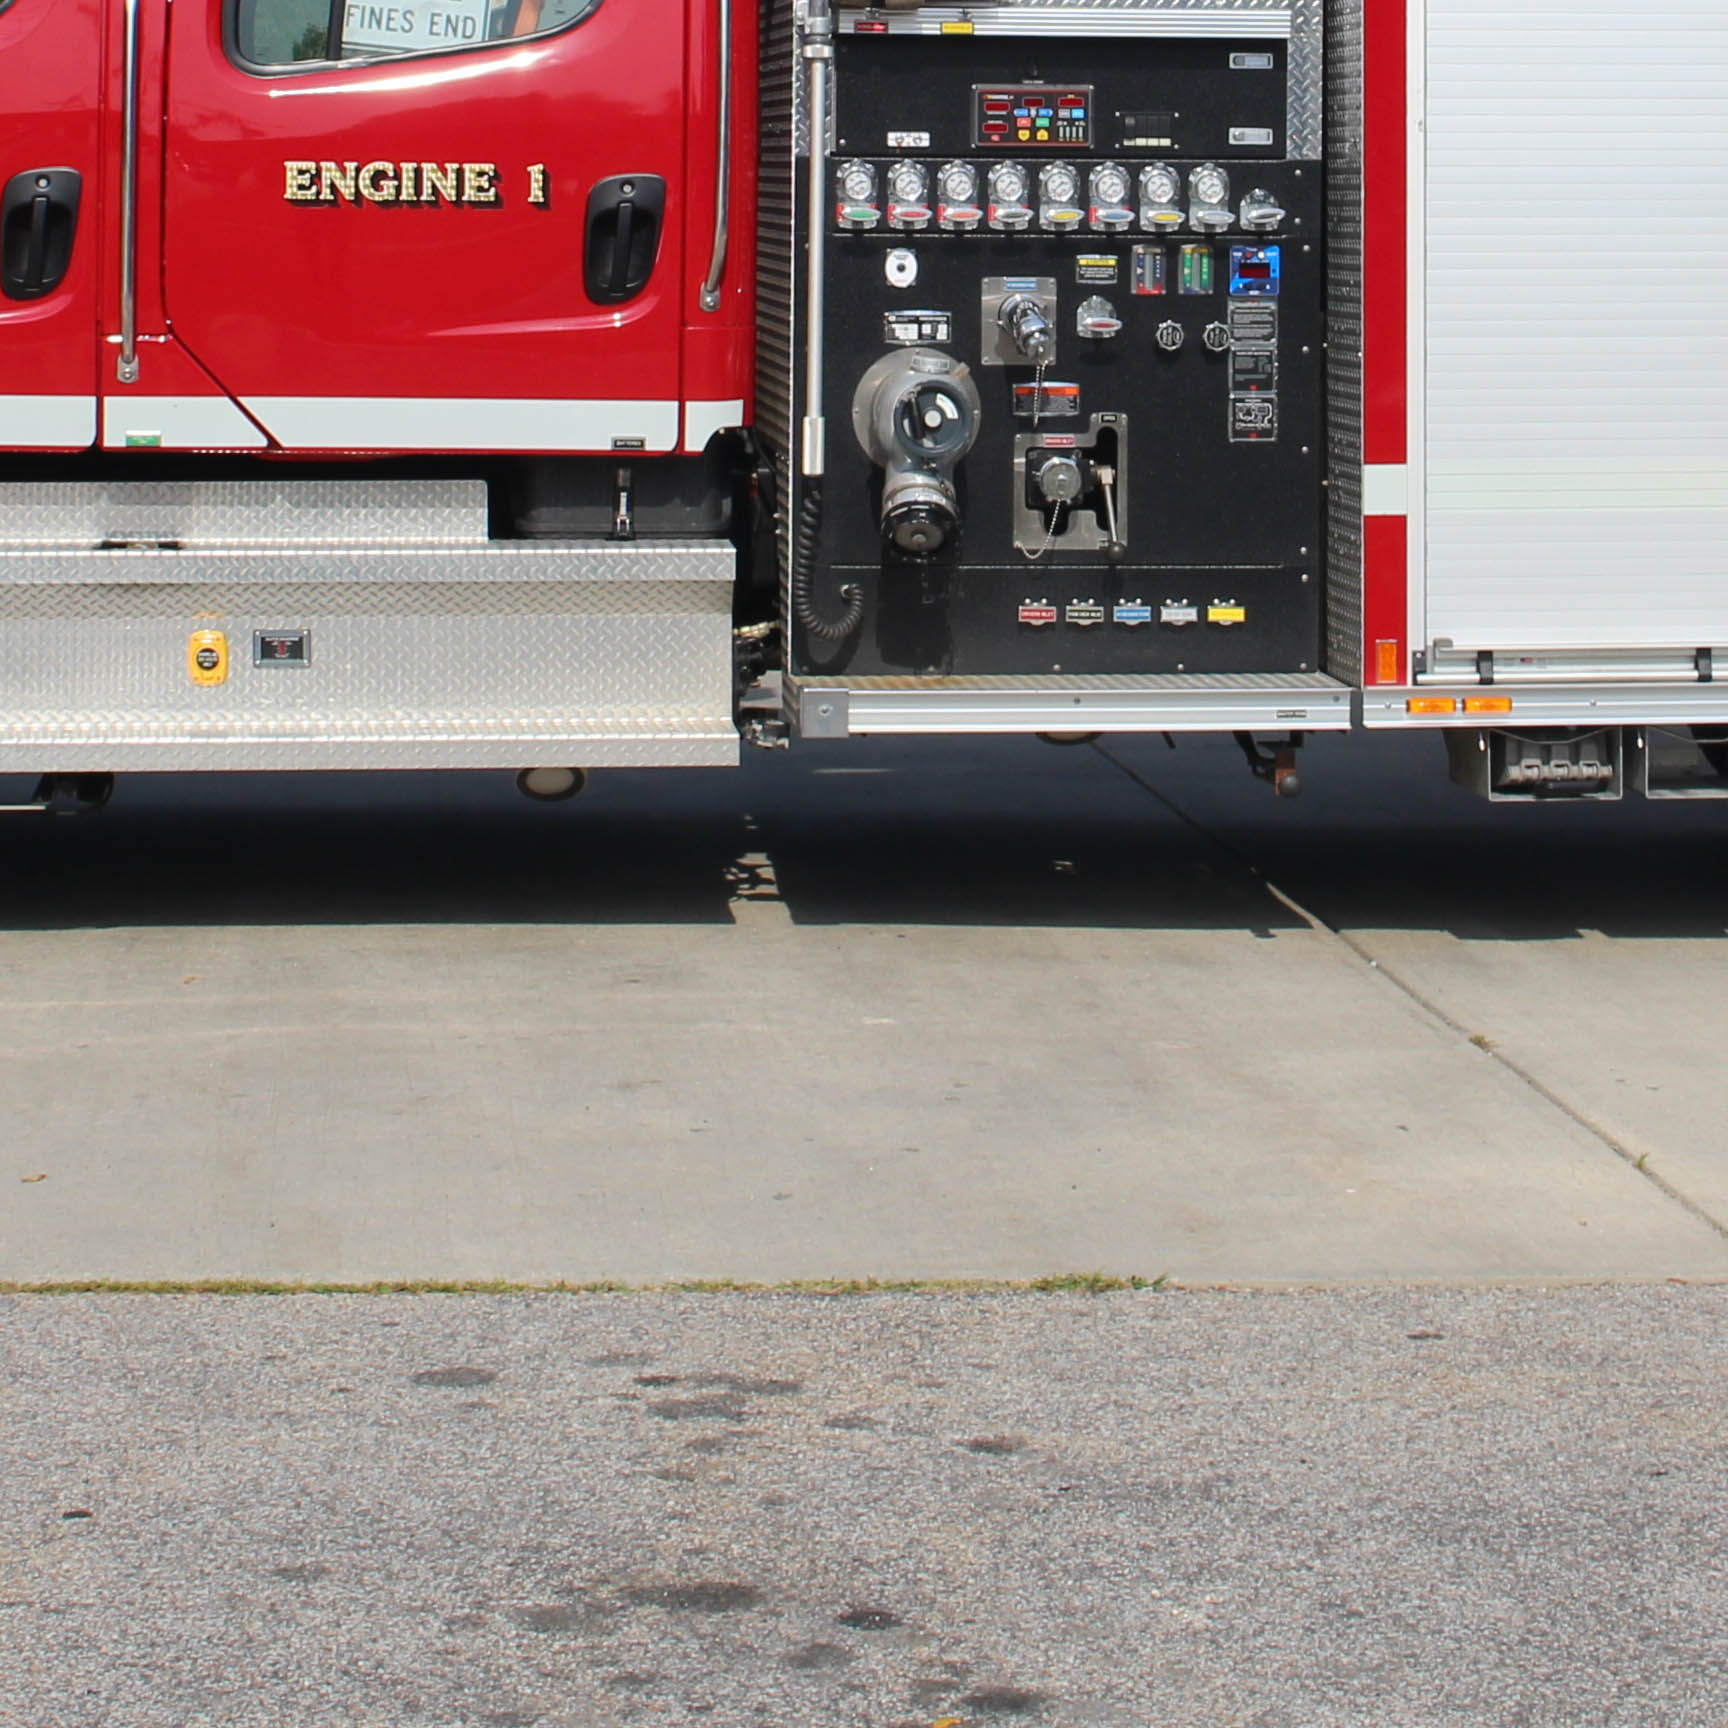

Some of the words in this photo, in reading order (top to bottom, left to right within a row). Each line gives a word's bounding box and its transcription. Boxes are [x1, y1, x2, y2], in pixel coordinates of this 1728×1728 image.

[345, 4, 416, 34] FINES
[428, 12, 477, 39] END
[283, 160, 500, 205] ENGINE
[526, 162, 549, 205] 1
